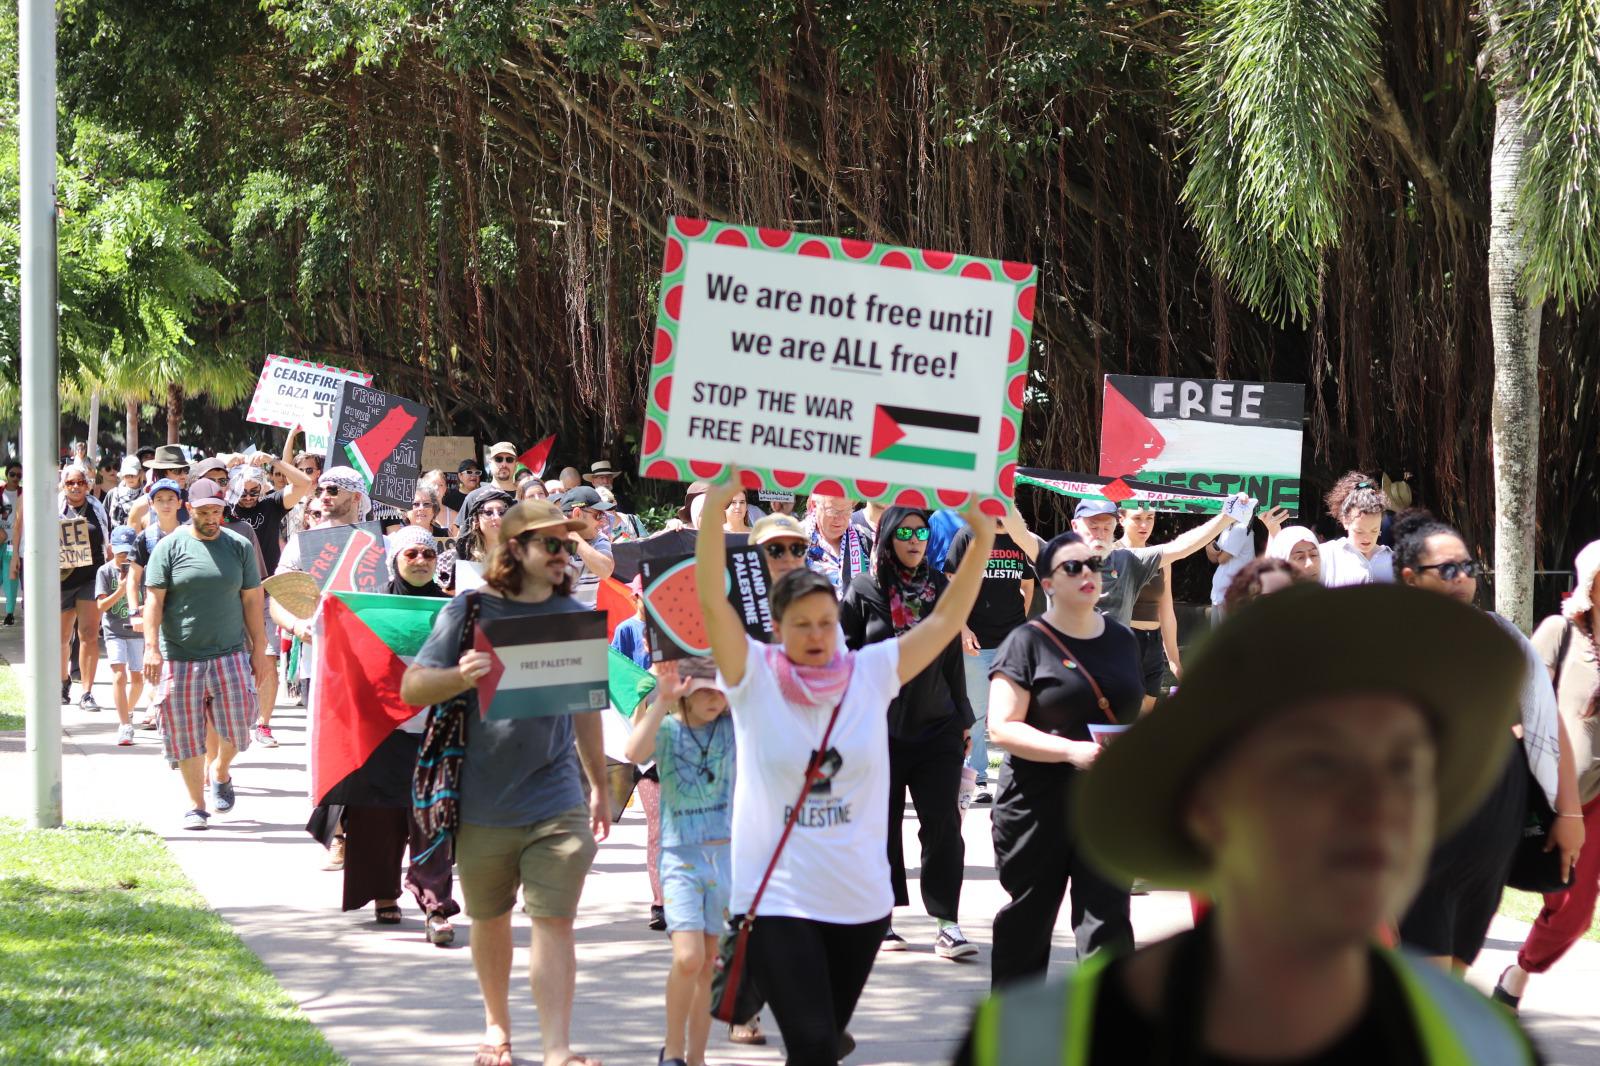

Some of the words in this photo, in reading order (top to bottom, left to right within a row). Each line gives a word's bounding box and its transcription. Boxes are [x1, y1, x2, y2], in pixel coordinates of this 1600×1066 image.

[706, 273, 748, 303] We
[756, 288, 802, 312] are
[809, 293, 856, 320] not
[866, 294, 921, 327] free
[929, 309, 993, 337] until
[731, 331, 772, 355] we
[780, 338, 825, 362] are
[832, 337, 882, 370] ALL
[890, 344, 958, 379] free!
[274, 367, 342, 390] CEASEFIRE
[277, 384, 309, 399] GAZA
[693, 381, 747, 407] STOP
[757, 388, 797, 414] THE
[805, 394, 853, 421] WAR
[1153, 381, 1265, 419] FREE
[688, 416, 742, 443] FREE
[751, 423, 862, 457] PALESTINE
[60, 520, 87, 546] EE
[310, 543, 339, 579] FREE
[732, 553, 759, 625] PALESTINE
[746, 551, 767, 596] STAND
[758, 597, 774, 633] WITH
[520, 660, 538, 670] FREE
[541, 657, 583, 669] PALESTINE
[784, 803, 852, 828] PLESTINE
